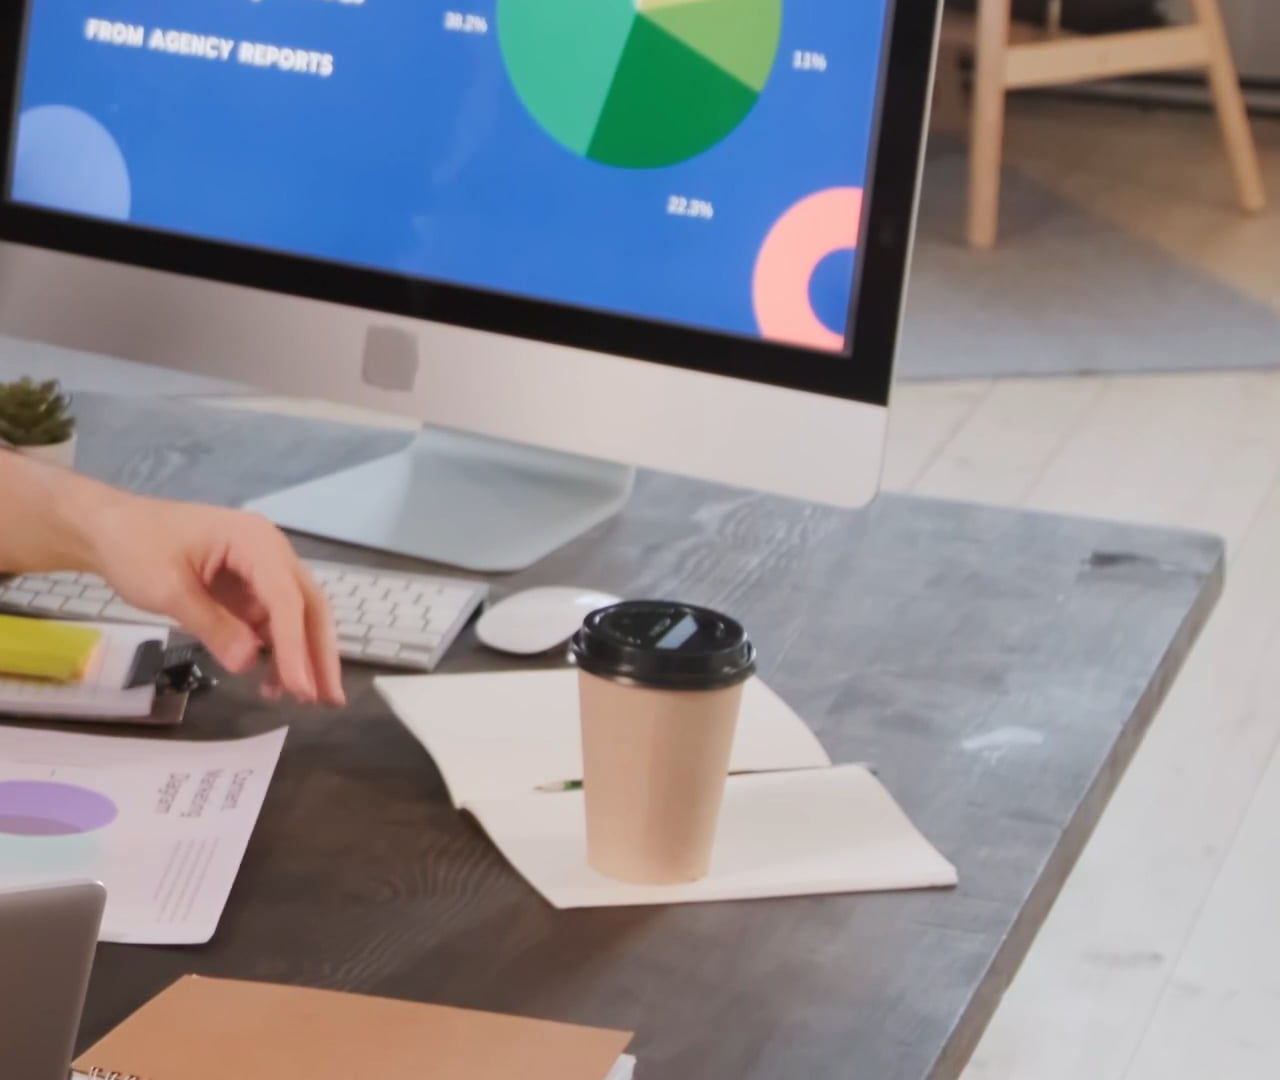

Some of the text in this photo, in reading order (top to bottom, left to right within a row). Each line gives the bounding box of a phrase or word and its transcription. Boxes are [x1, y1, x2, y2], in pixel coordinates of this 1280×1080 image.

[85, 18, 334, 77] FROM AGENCY REPORTS
